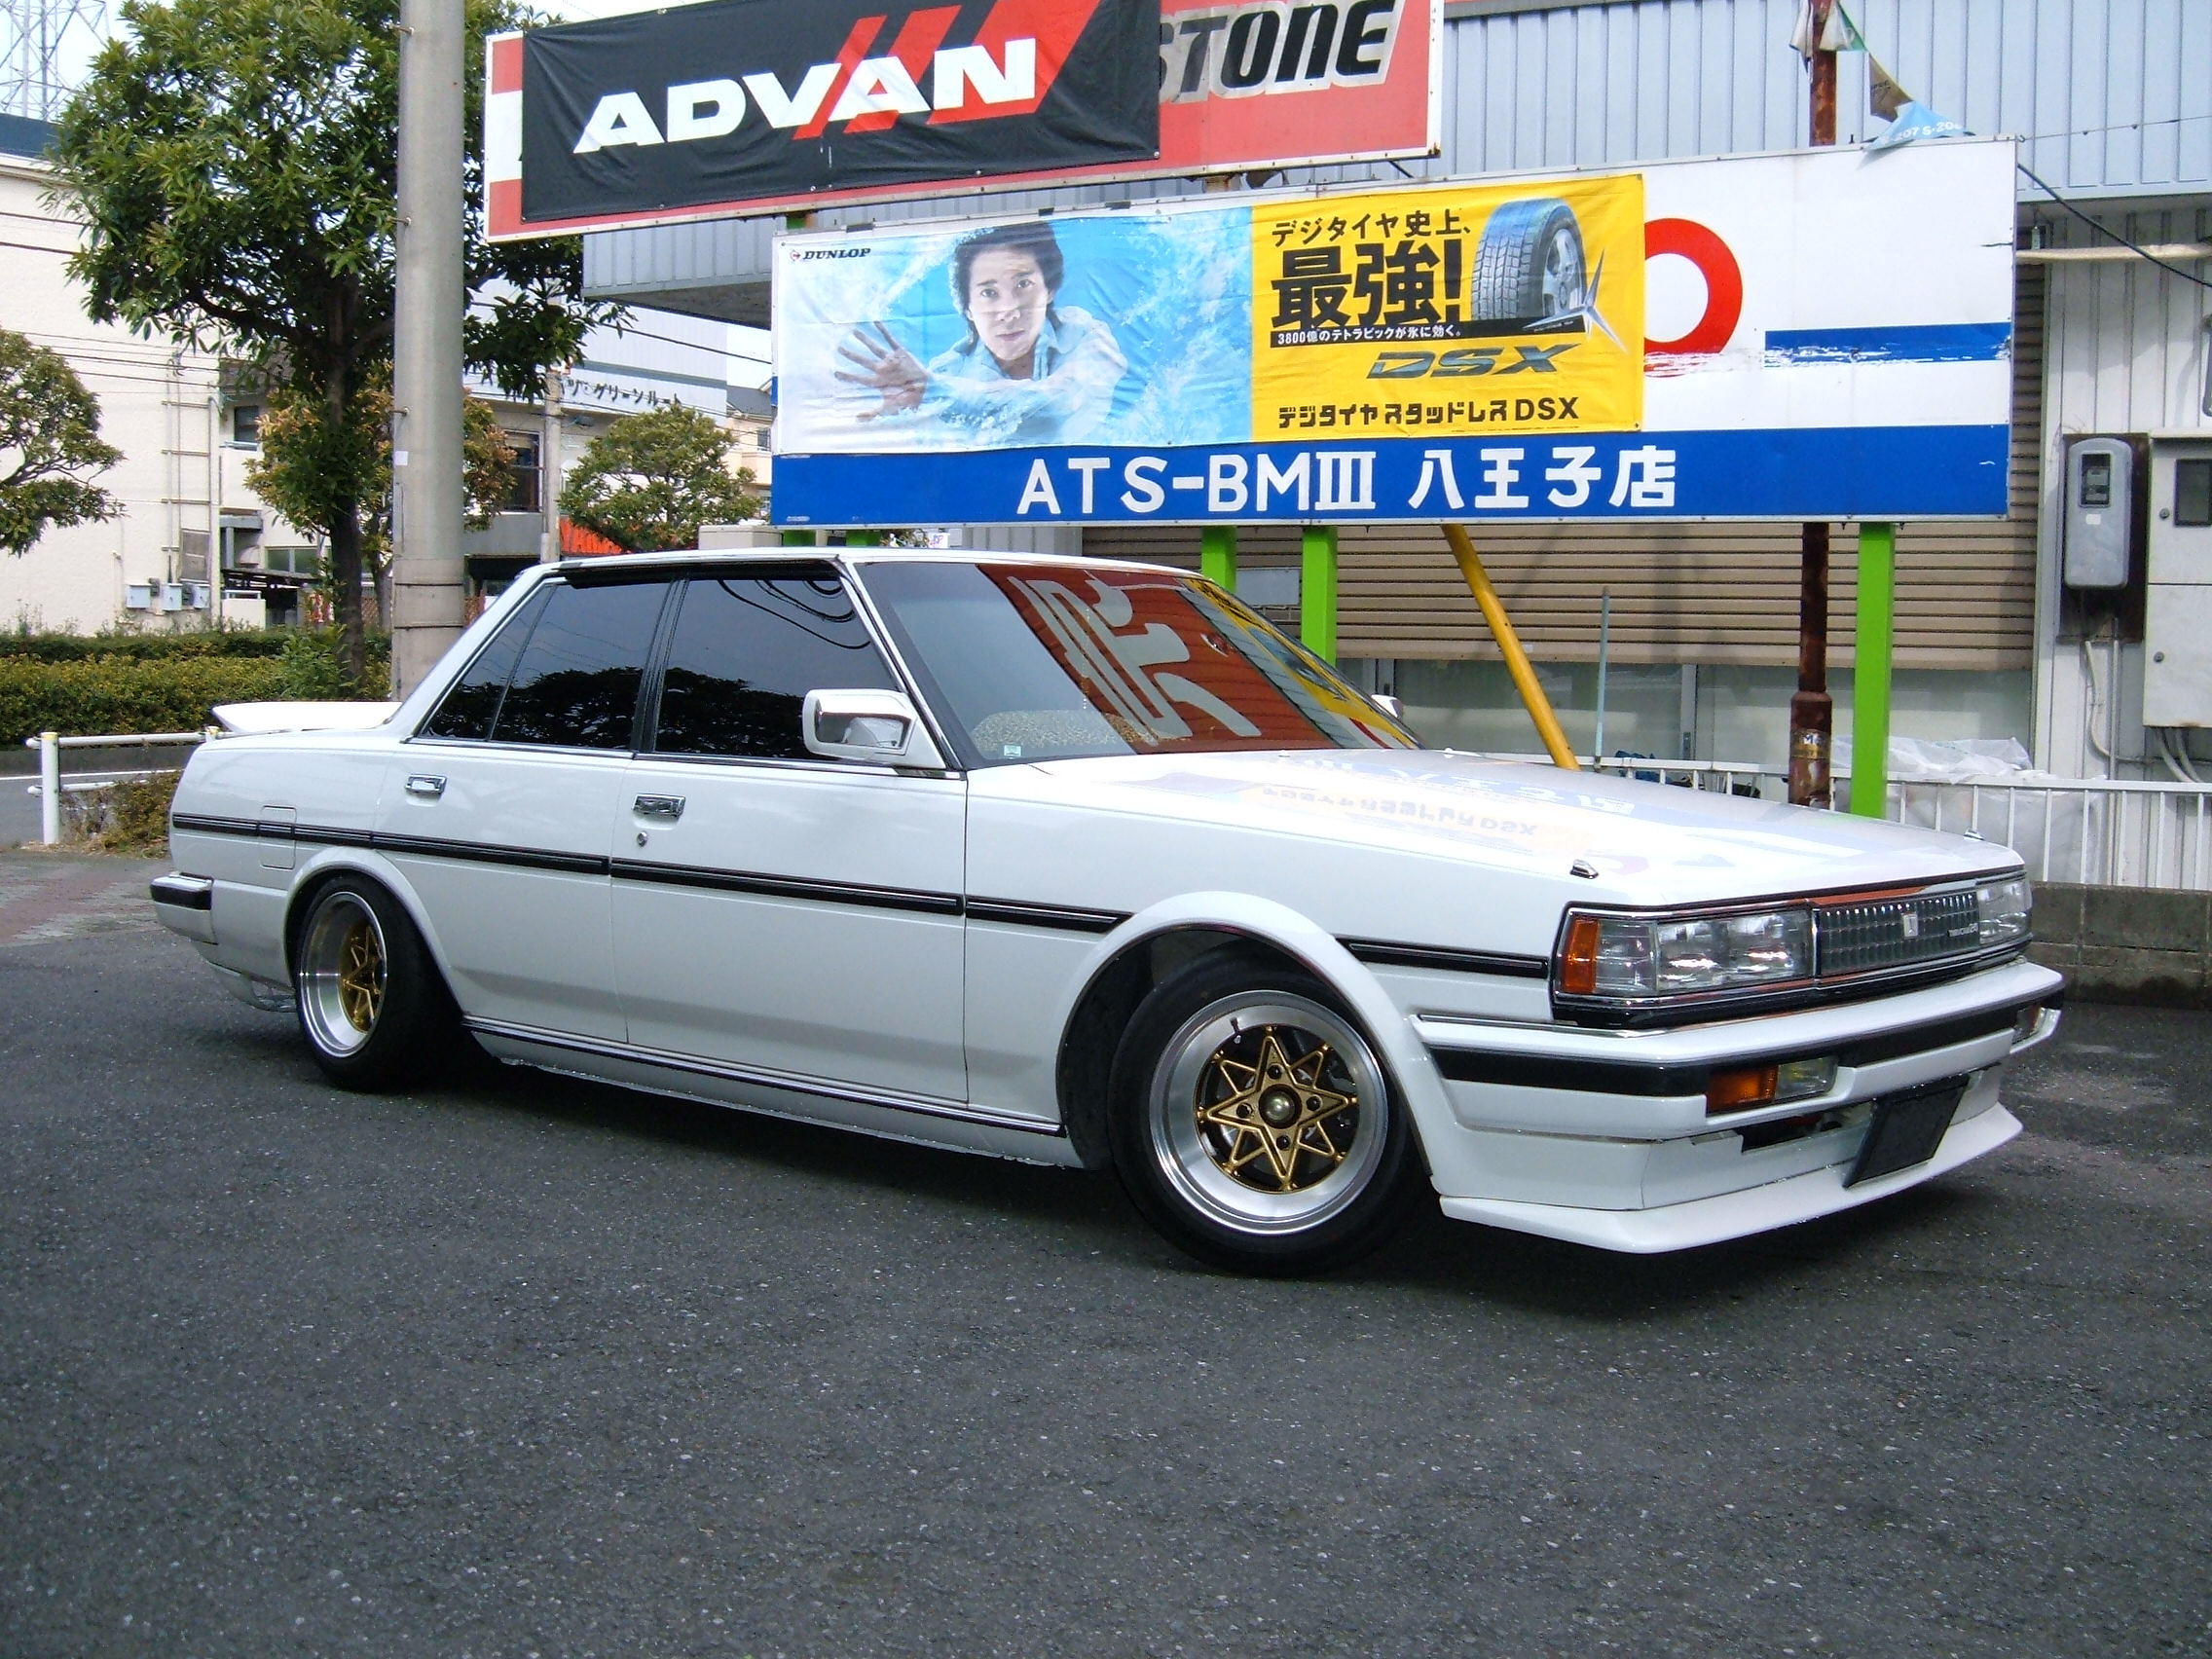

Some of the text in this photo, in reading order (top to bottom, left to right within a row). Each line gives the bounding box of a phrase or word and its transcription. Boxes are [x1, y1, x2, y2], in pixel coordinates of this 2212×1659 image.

[572, 38, 1037, 154] ADVAN
[803, 248, 871, 260] DUNLOP
[1271, 239, 1462, 329] 最強!
[1366, 343, 1581, 379] DSX
[1408, 445, 1677, 509] 八王子店
